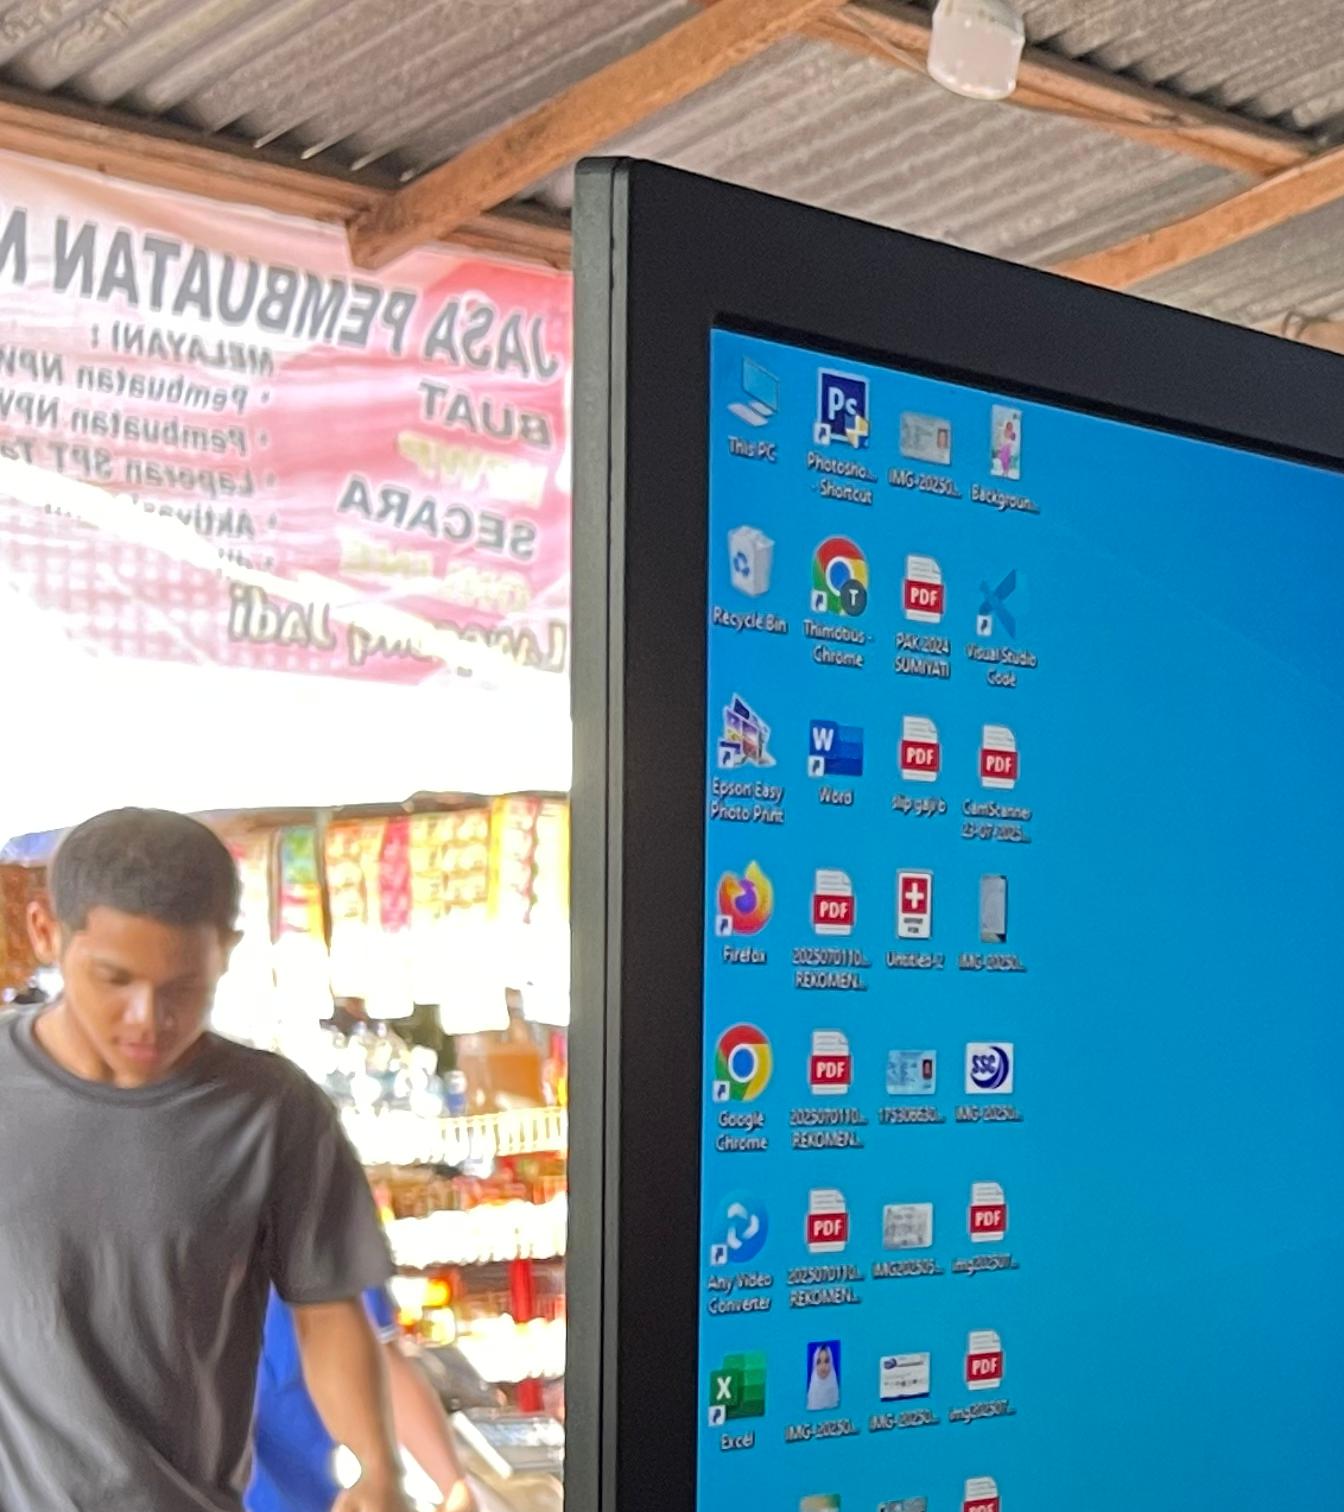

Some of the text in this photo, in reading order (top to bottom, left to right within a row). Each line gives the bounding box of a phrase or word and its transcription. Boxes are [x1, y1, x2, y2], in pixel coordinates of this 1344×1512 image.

[827, 389, 858, 421] Ps
[728, 435, 776, 461] This PC
[820, 479, 872, 504] Shortcut
[910, 587, 939, 607] PDF
[713, 606, 788, 632] Recycle Bin
[814, 646, 864, 667] Chrome
[966, 643, 1037, 667] Visual Studio
[987, 668, 1017, 688] Code
[813, 727, 835, 751] W
[906, 747, 935, 766] PDF
[985, 756, 1012, 773] PDF
[712, 777, 784, 803] Epson Easy
[819, 786, 853, 805] Word
[711, 800, 784, 823] Photo Print
[820, 900, 848, 919] PDF
[723, 945, 767, 963] Firefox
[816, 1060, 845, 1079] PDF
[719, 1110, 765, 1131] Google
[716, 1133, 768, 1151] Chrome
[813, 1218, 842, 1237] PDF
[974, 1209, 1002, 1228] PDF
[708, 1272, 773, 1295] Any Video
[708, 1296, 771, 1315] Converter
[972, 1356, 999, 1376] PDF
[716, 1376, 732, 1401] X
[721, 1432, 755, 1451] Excel
